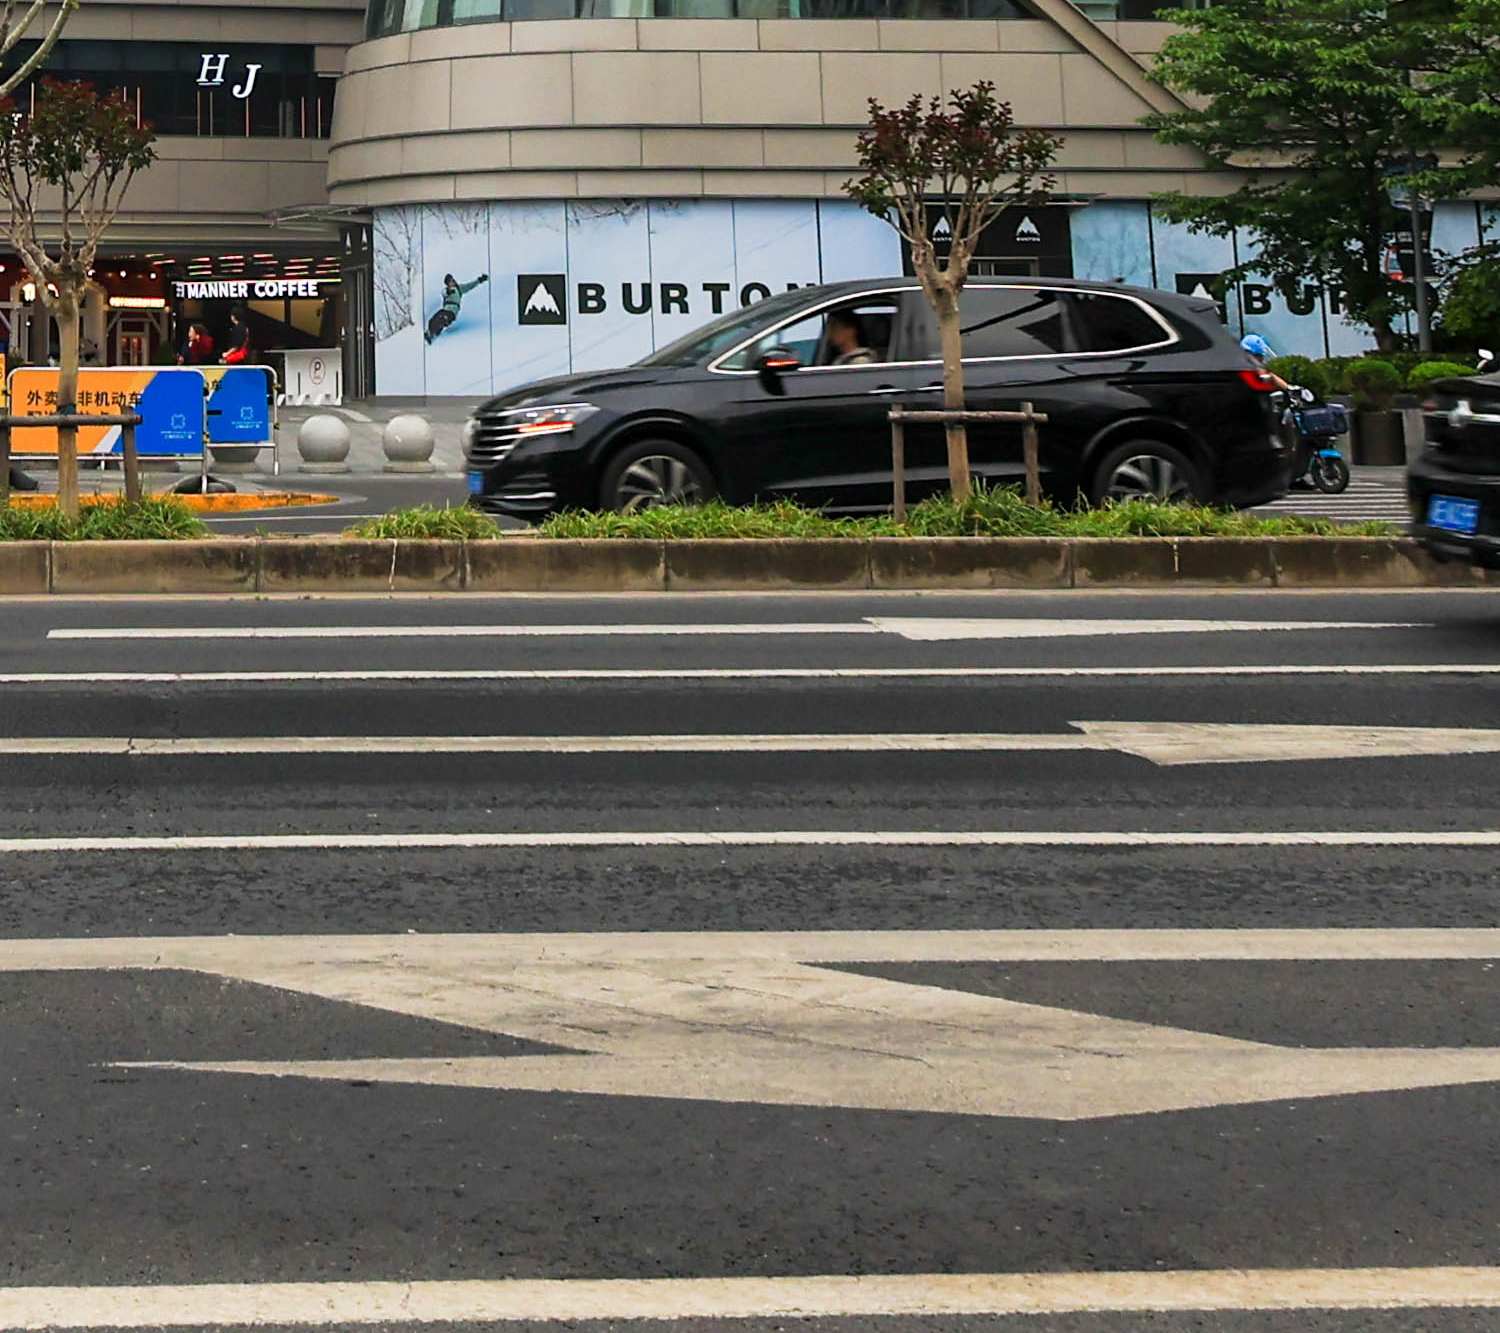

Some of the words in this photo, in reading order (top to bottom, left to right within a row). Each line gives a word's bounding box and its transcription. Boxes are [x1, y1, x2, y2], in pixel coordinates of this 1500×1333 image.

[187, 282, 248, 299] MANNER
[254, 282, 318, 297] COFFEE
[578, 282, 817, 314] BURTO
[27, 390, 143, 407] 外卖非机动车
